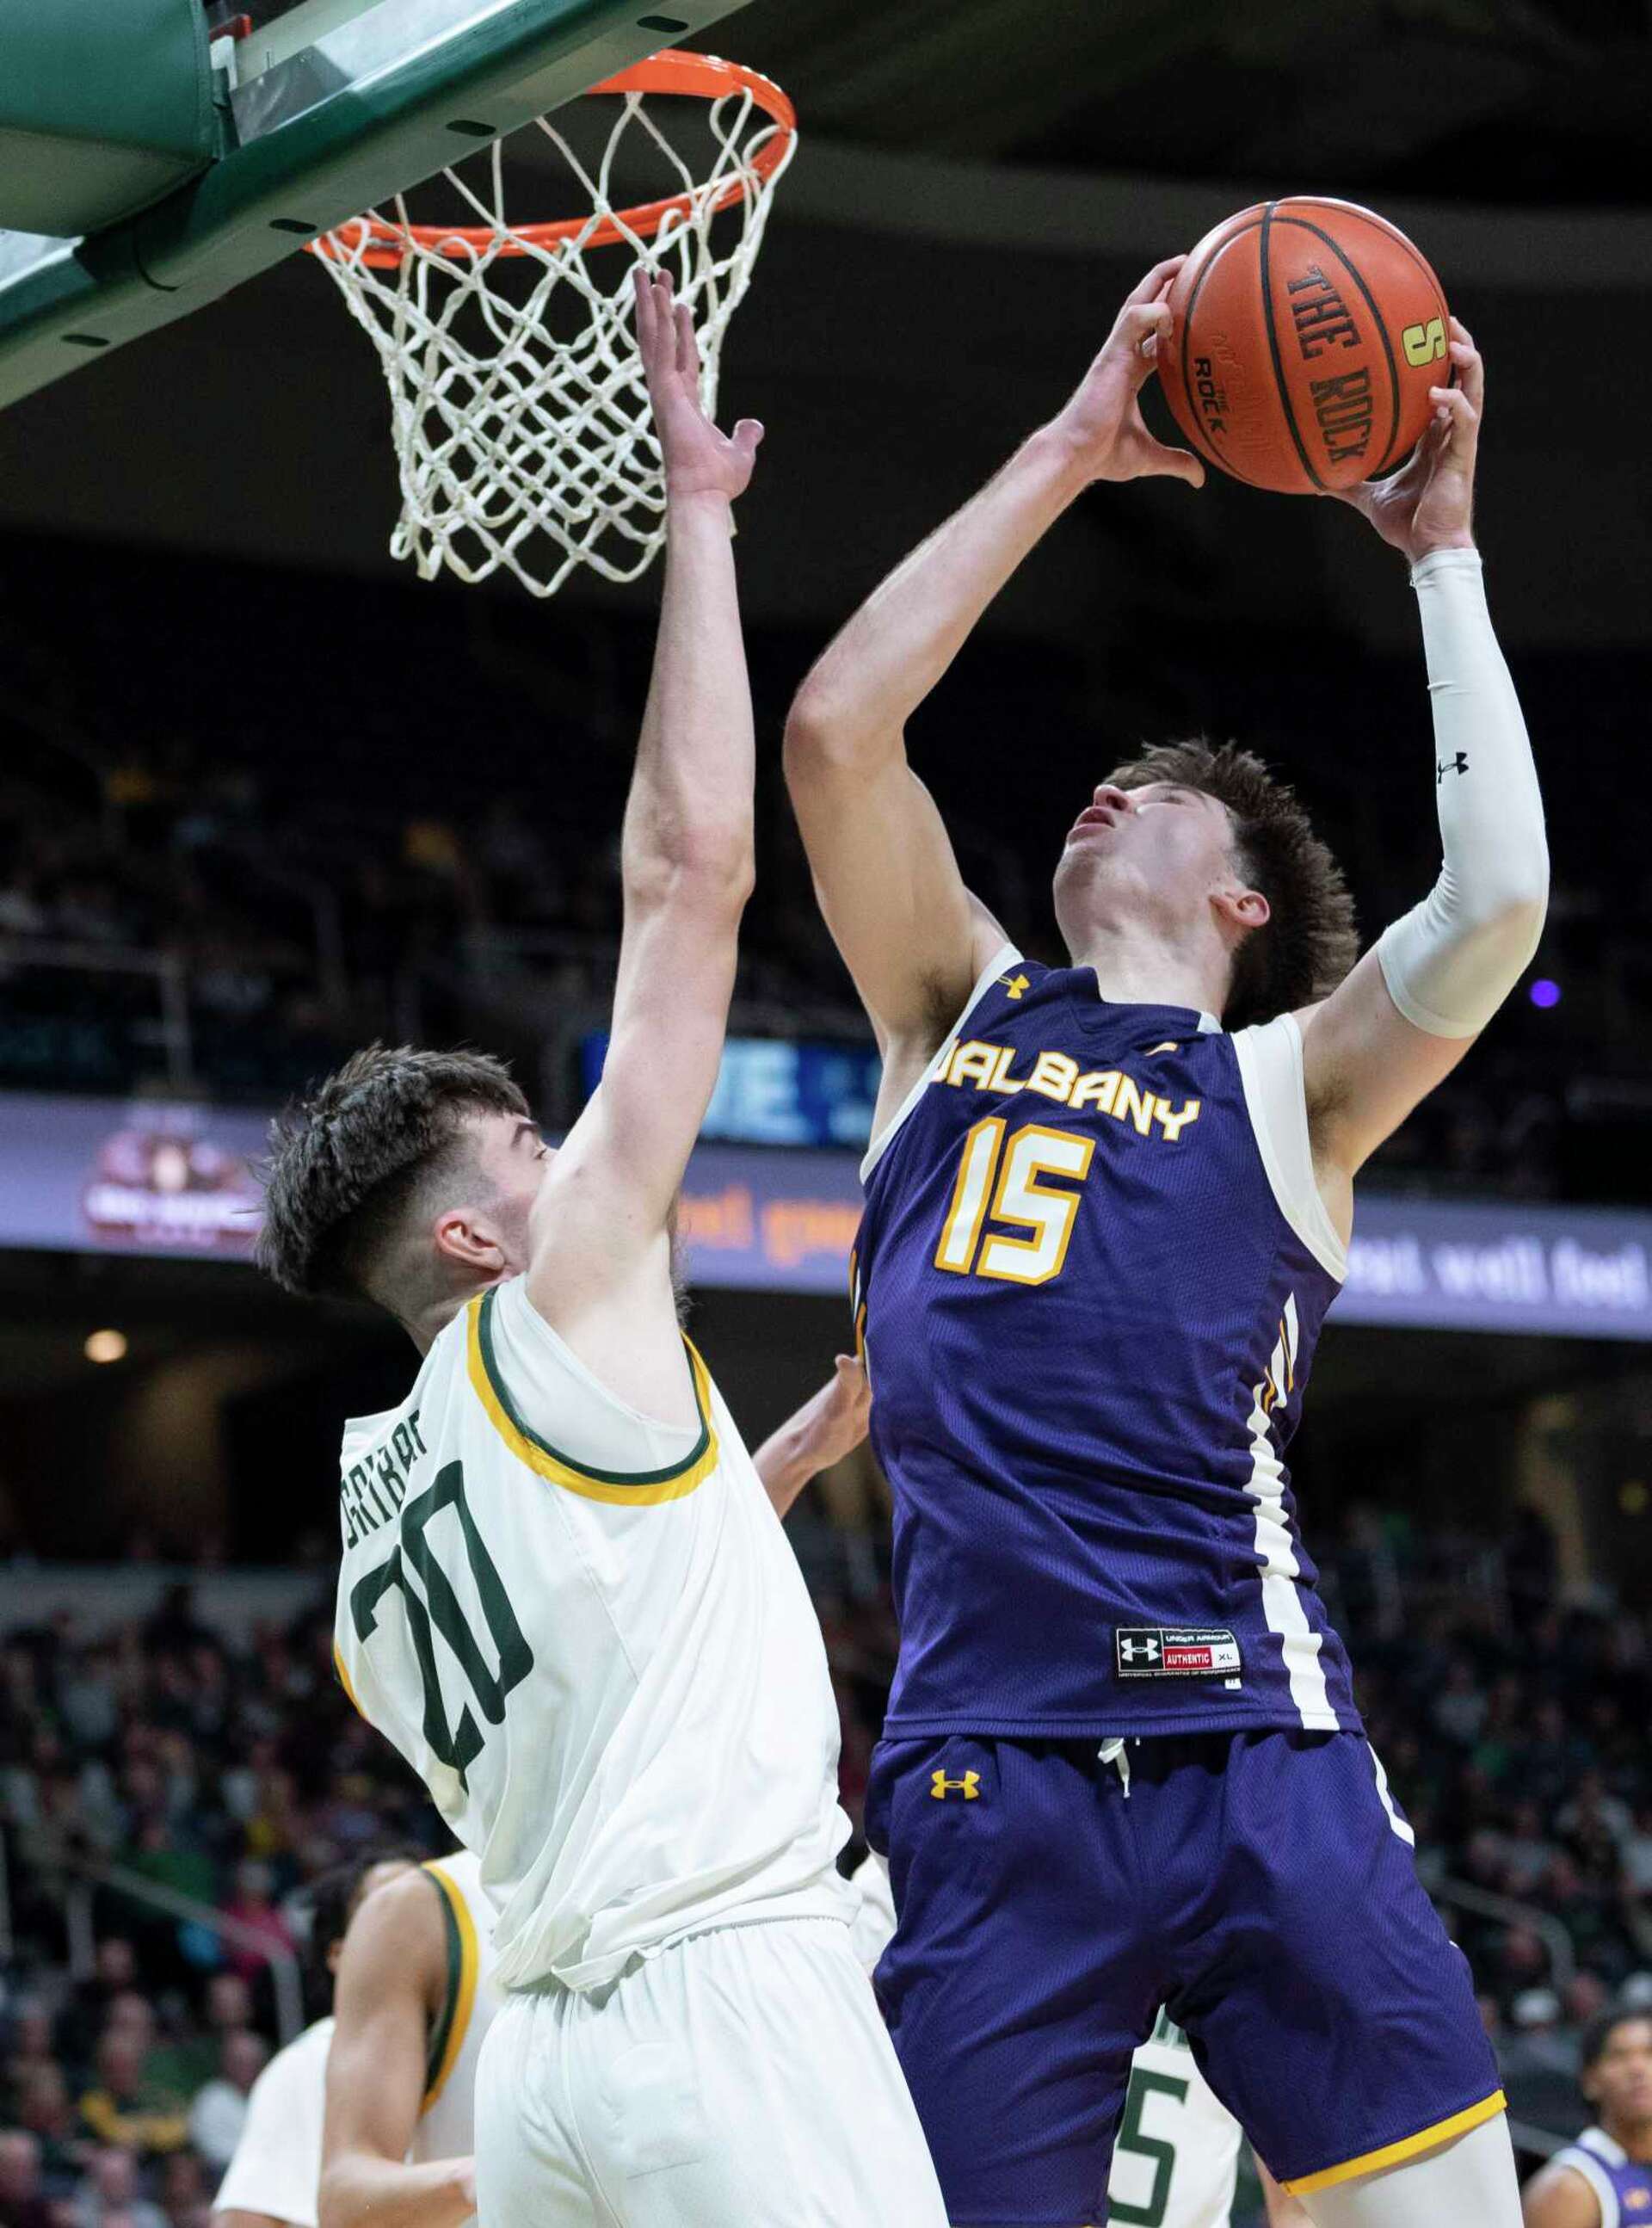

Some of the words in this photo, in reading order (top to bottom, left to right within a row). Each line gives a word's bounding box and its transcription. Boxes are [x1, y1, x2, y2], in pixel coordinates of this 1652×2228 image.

[1286, 265, 1362, 360] THE
[1401, 316, 1446, 367] S
[1194, 357, 1228, 433] ROCK
[1310, 366, 1376, 466] ROCK
[934, 1116, 1095, 1286] 15
[350, 1460, 534, 1796] 20
[1167, 1653, 1210, 1665] AUTHENTIC
[1218, 1653, 1233, 1662] XL
[1107, 2066, 1190, 2227] 5
